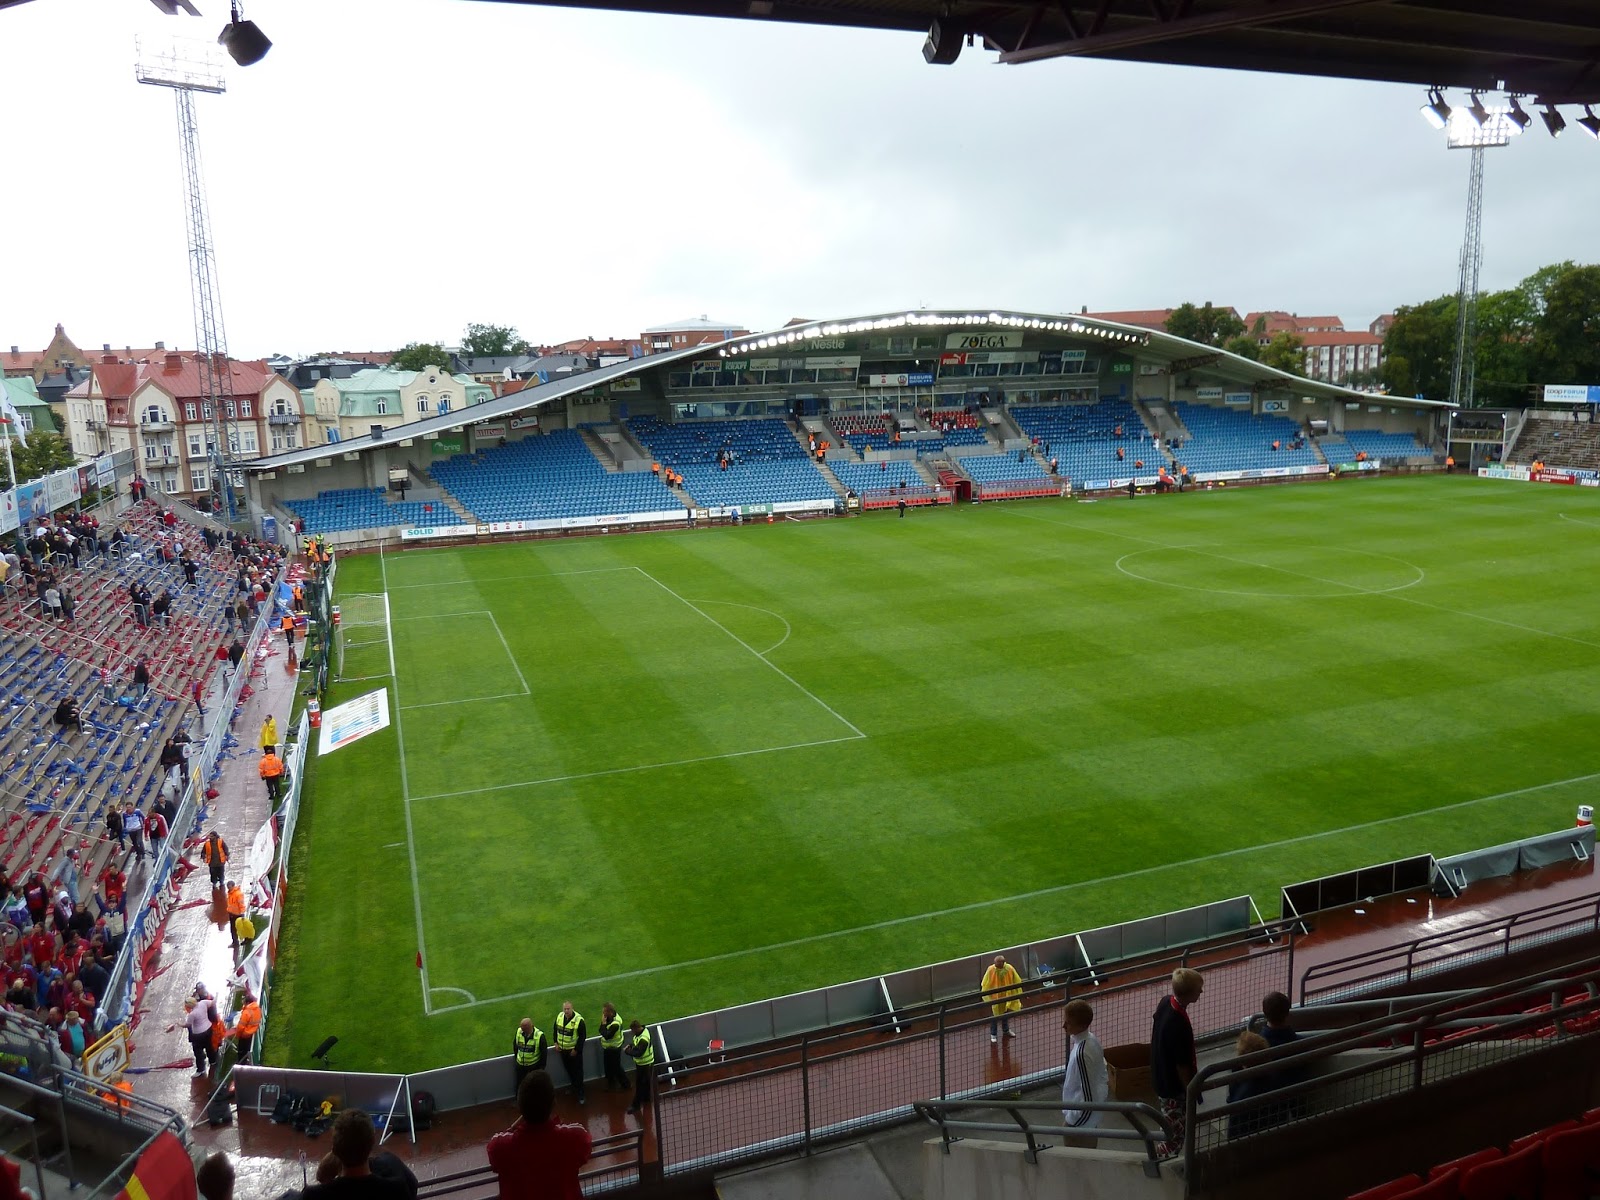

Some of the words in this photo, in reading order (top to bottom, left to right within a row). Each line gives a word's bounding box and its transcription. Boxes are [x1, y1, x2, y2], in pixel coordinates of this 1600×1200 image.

[1063, 351, 1086, 359] SOLID
[1113, 364, 1131, 372] SEB
[443, 443, 461, 452] bring
[748, 505, 767, 514] SEB
[407, 528, 434, 536] SOLID
